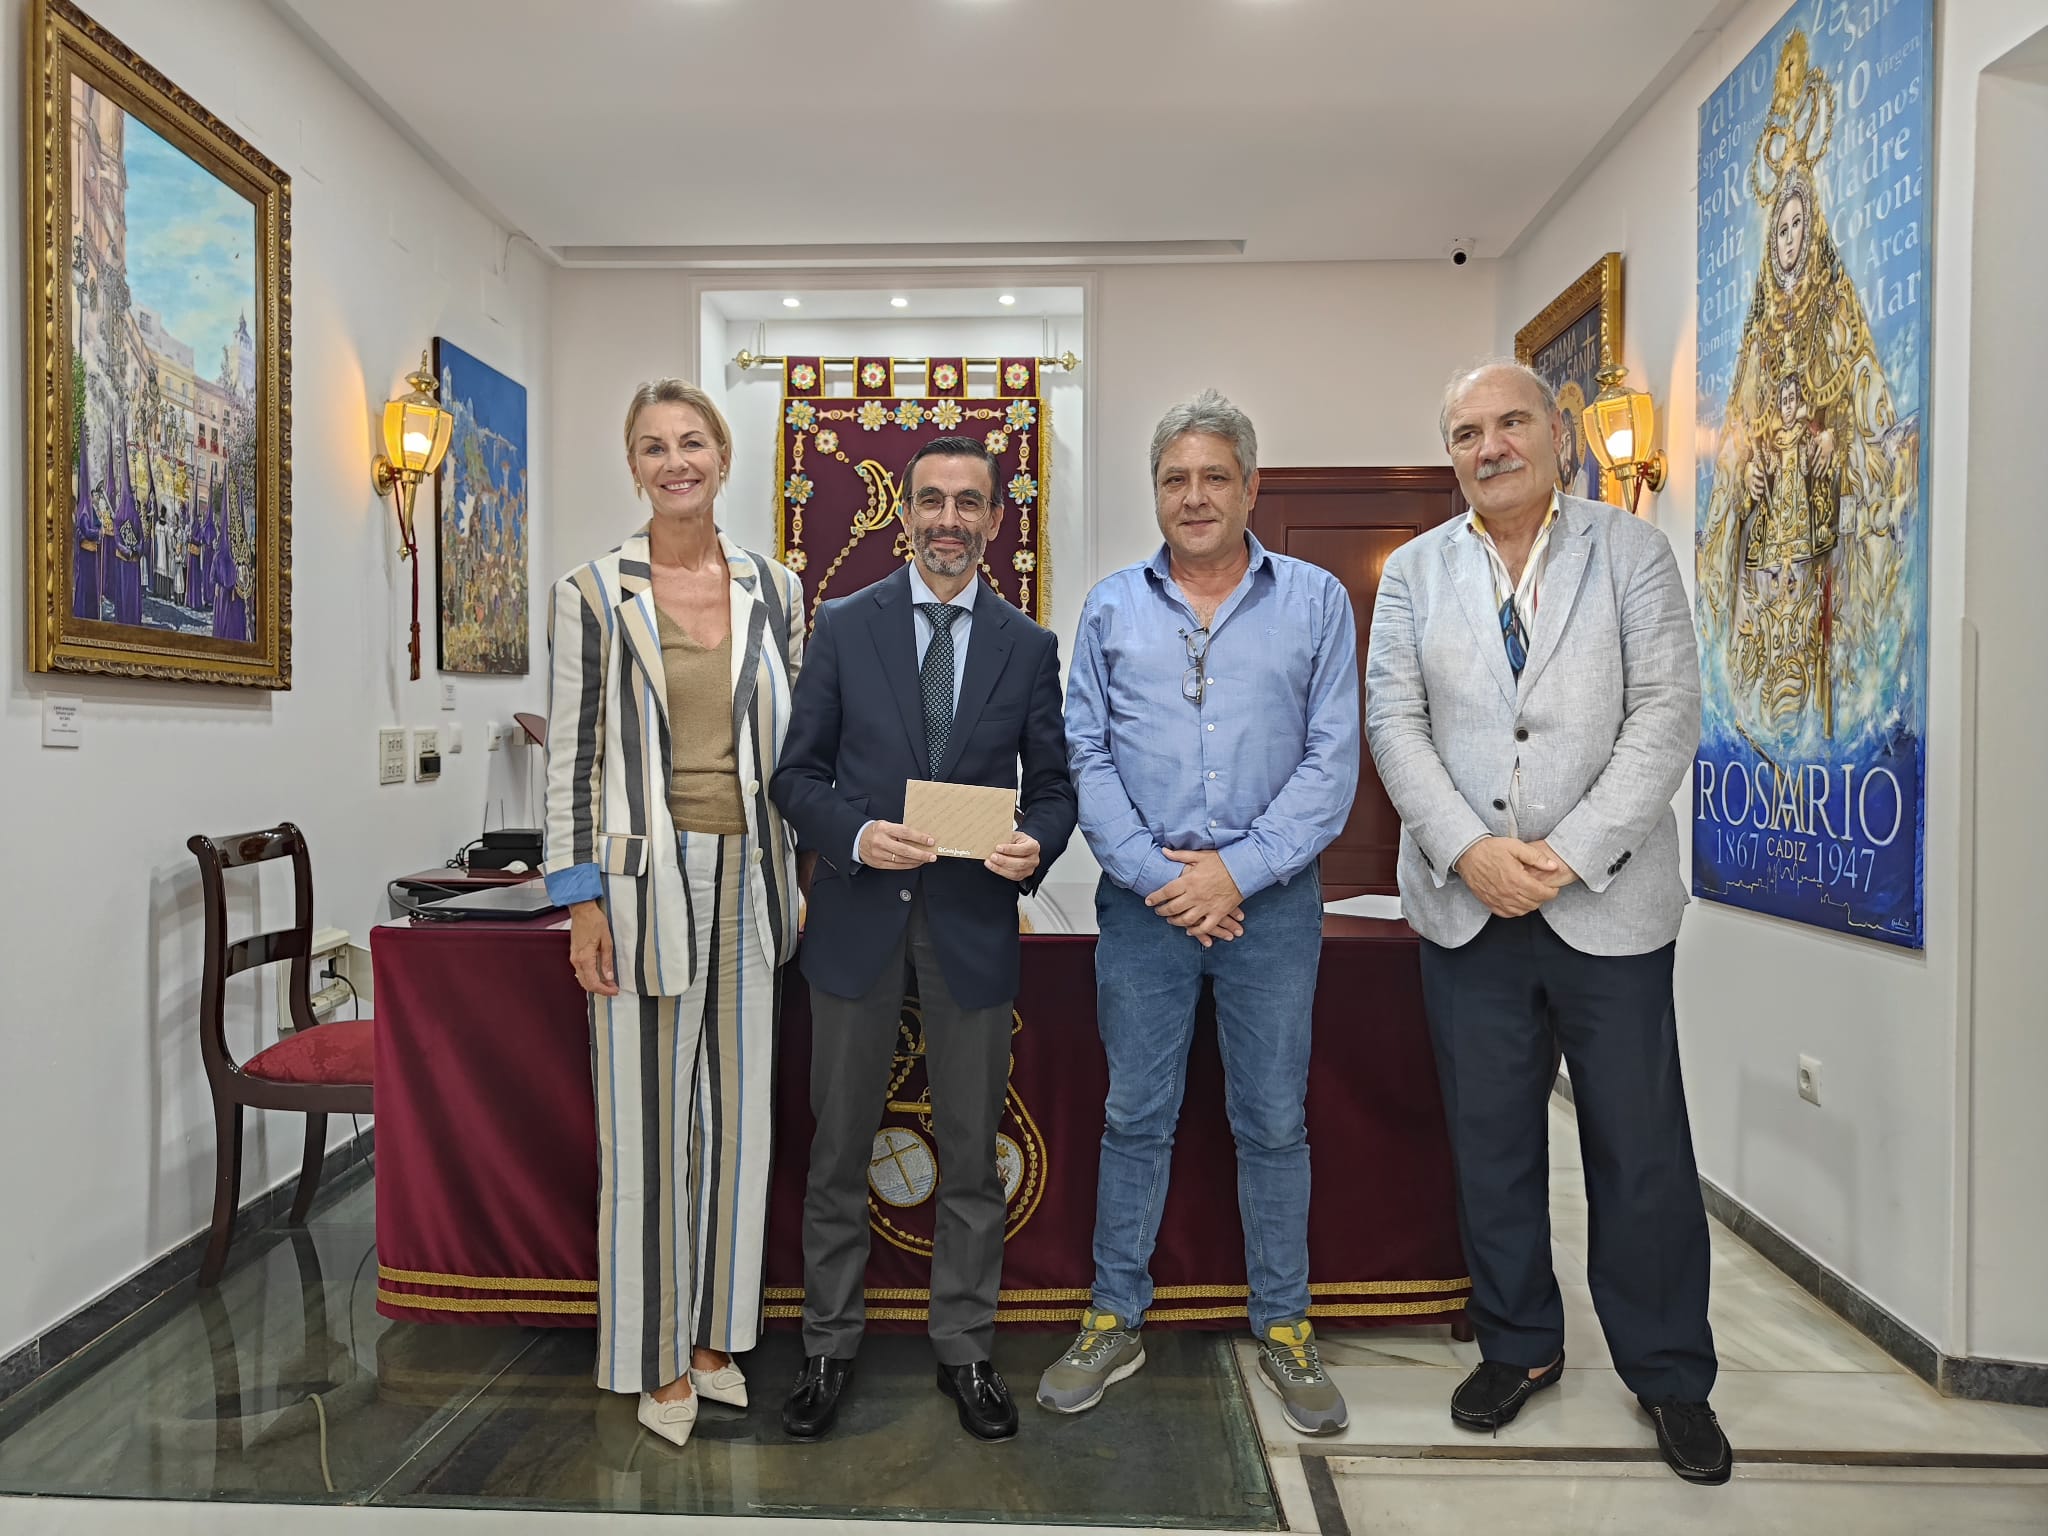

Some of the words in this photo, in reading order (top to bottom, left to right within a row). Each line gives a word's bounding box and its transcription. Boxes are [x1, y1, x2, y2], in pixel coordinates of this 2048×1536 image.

[1876, 35, 1919, 78] Virgen
[1820, 128, 1911, 213] Madre
[1864, 220, 1918, 275] Arca
[1697, 760, 1902, 847] ROSARIO
[1714, 828, 1760, 871] 1867
[1767, 835, 1807, 862] CÁDIZ
[1815, 842, 1876, 893] 1947
